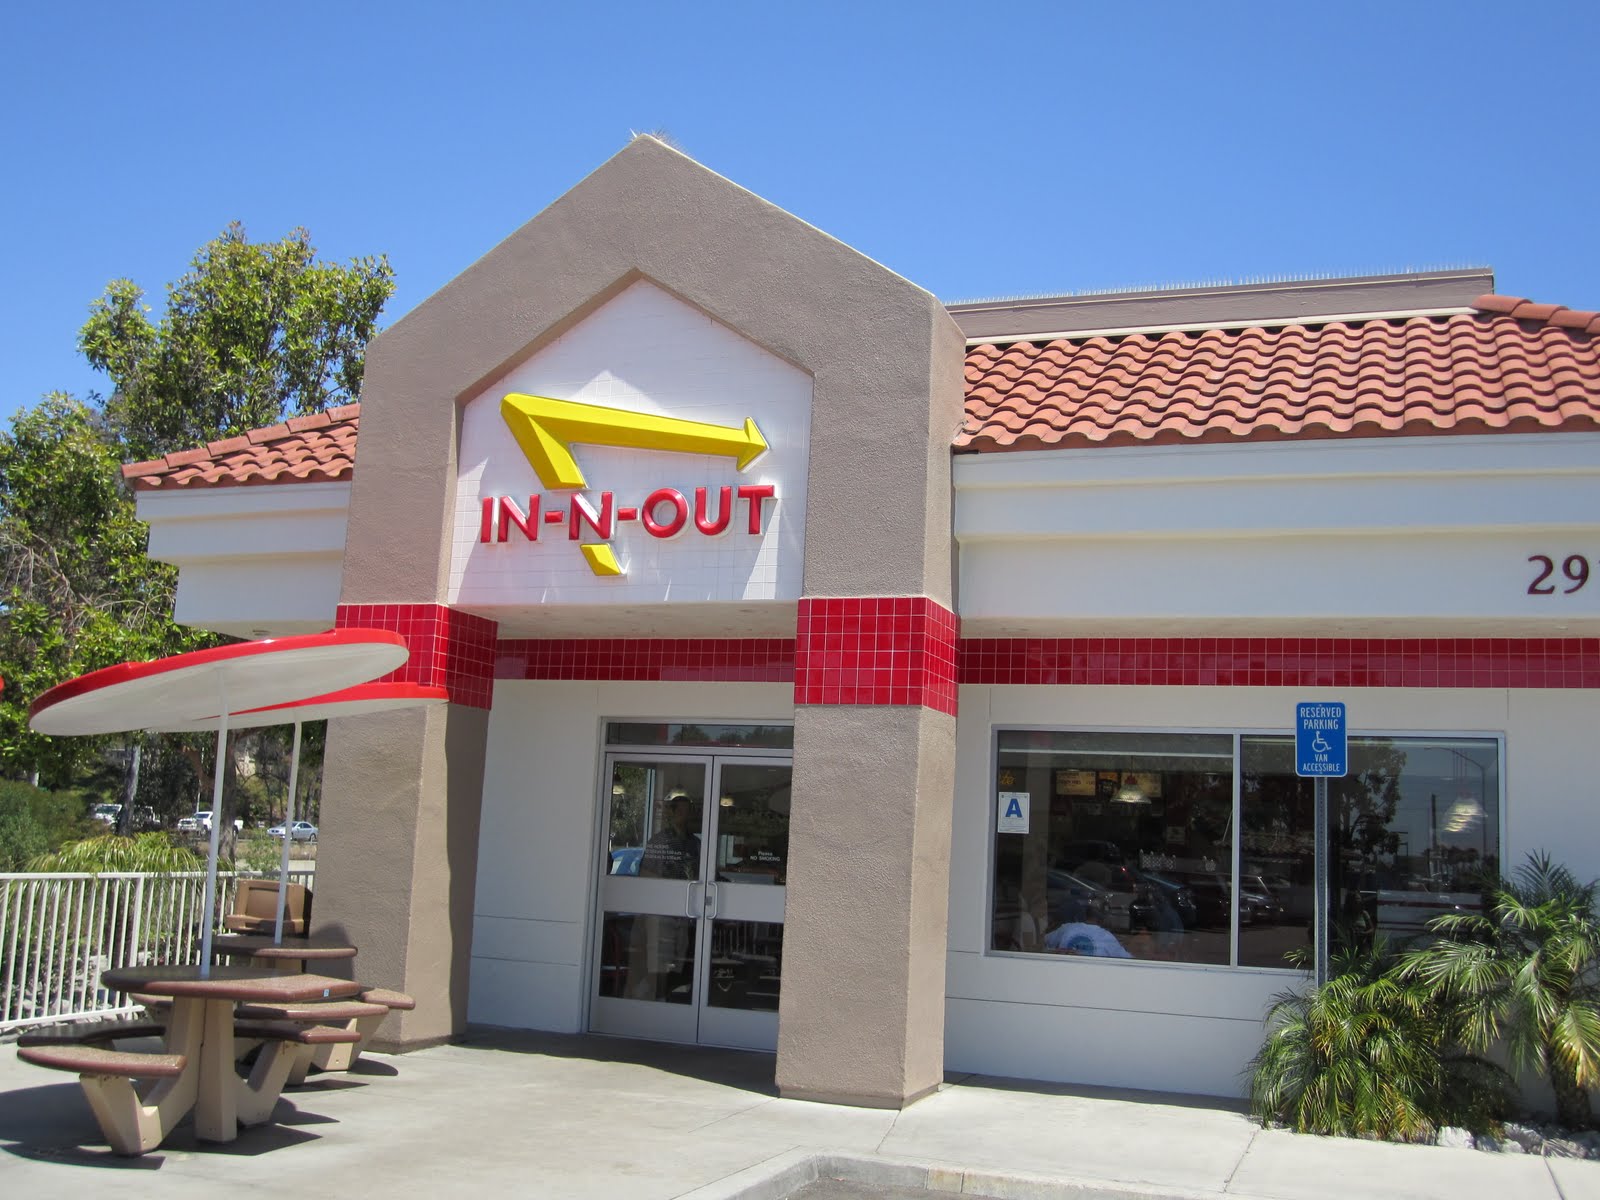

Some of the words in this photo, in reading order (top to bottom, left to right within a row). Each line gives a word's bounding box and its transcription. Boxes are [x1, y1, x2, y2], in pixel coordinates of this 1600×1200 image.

[480, 485, 776, 543] IN-N-OUT
[1527, 554, 1600, 595] 29
[1300, 707, 1341, 718] RESERVED
[1303, 718, 1339, 729] PARKING
[1314, 753, 1328, 762] VAN
[1302, 762, 1340, 772] ACCESSIBLE
[1005, 798, 1023, 818] A
